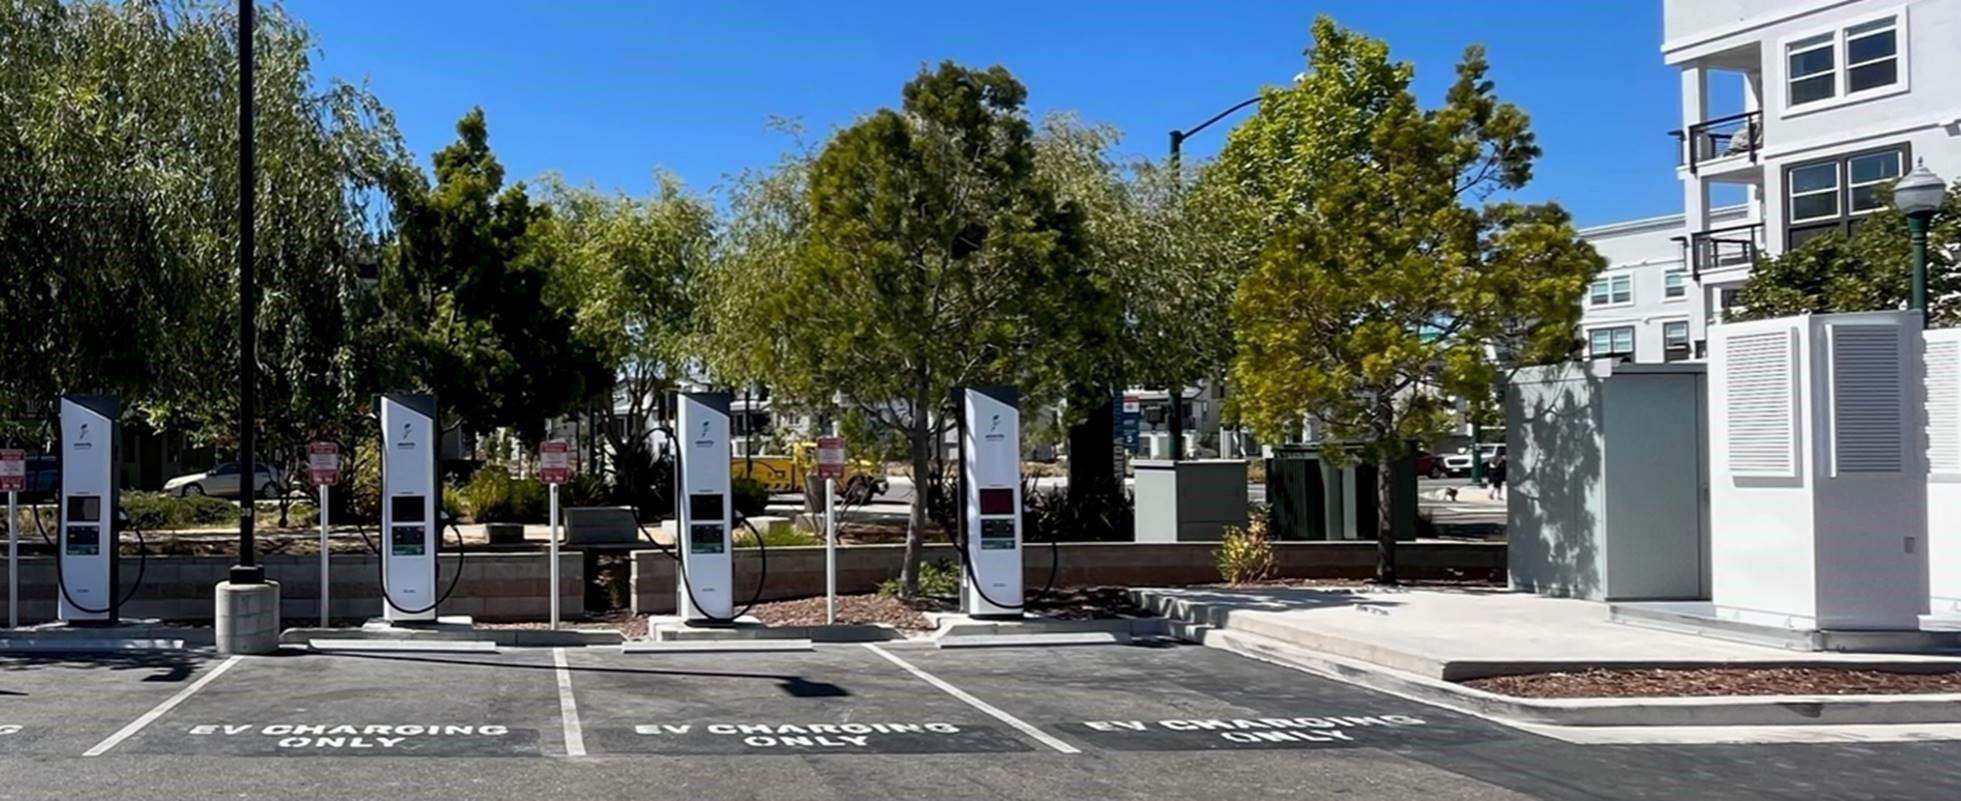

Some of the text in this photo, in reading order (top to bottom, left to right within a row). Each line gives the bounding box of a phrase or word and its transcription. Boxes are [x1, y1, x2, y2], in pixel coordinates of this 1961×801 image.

[634, 722, 960, 735] EV CHARGING
[1084, 714, 1427, 732] EV CHARGING
[188, 724, 509, 736] EV CHARGING
[277, 736, 406, 748] ONLY
[742, 735, 868, 747] ONLY
[1220, 730, 1355, 743] ONLY
